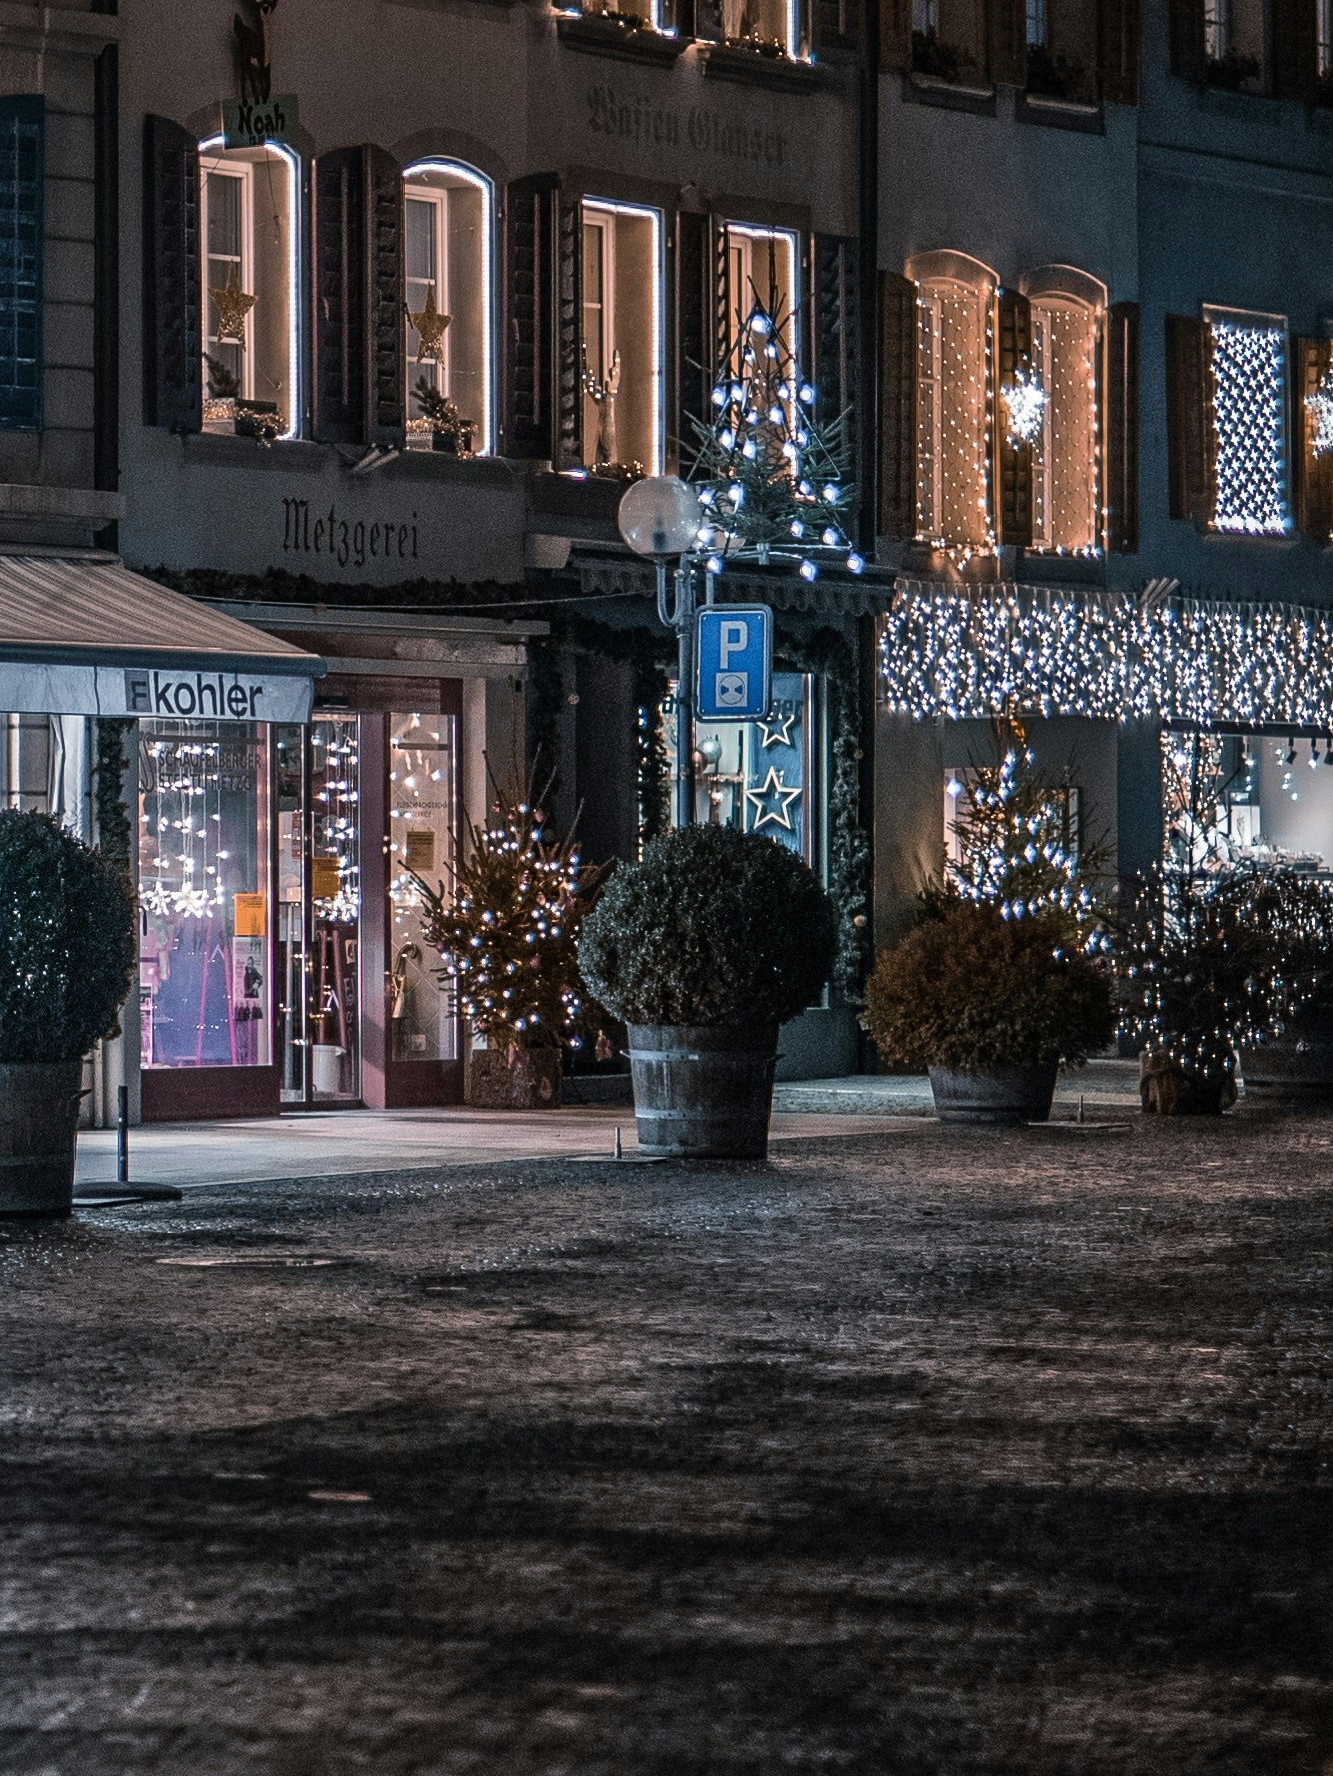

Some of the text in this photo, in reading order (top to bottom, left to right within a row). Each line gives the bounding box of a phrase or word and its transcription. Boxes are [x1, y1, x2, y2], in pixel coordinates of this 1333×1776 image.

[238, 102, 285, 135] Noah
[283, 497, 418, 567] Metzgerei
[720, 620, 748, 670] P
[153, 671, 263, 717] kohler
